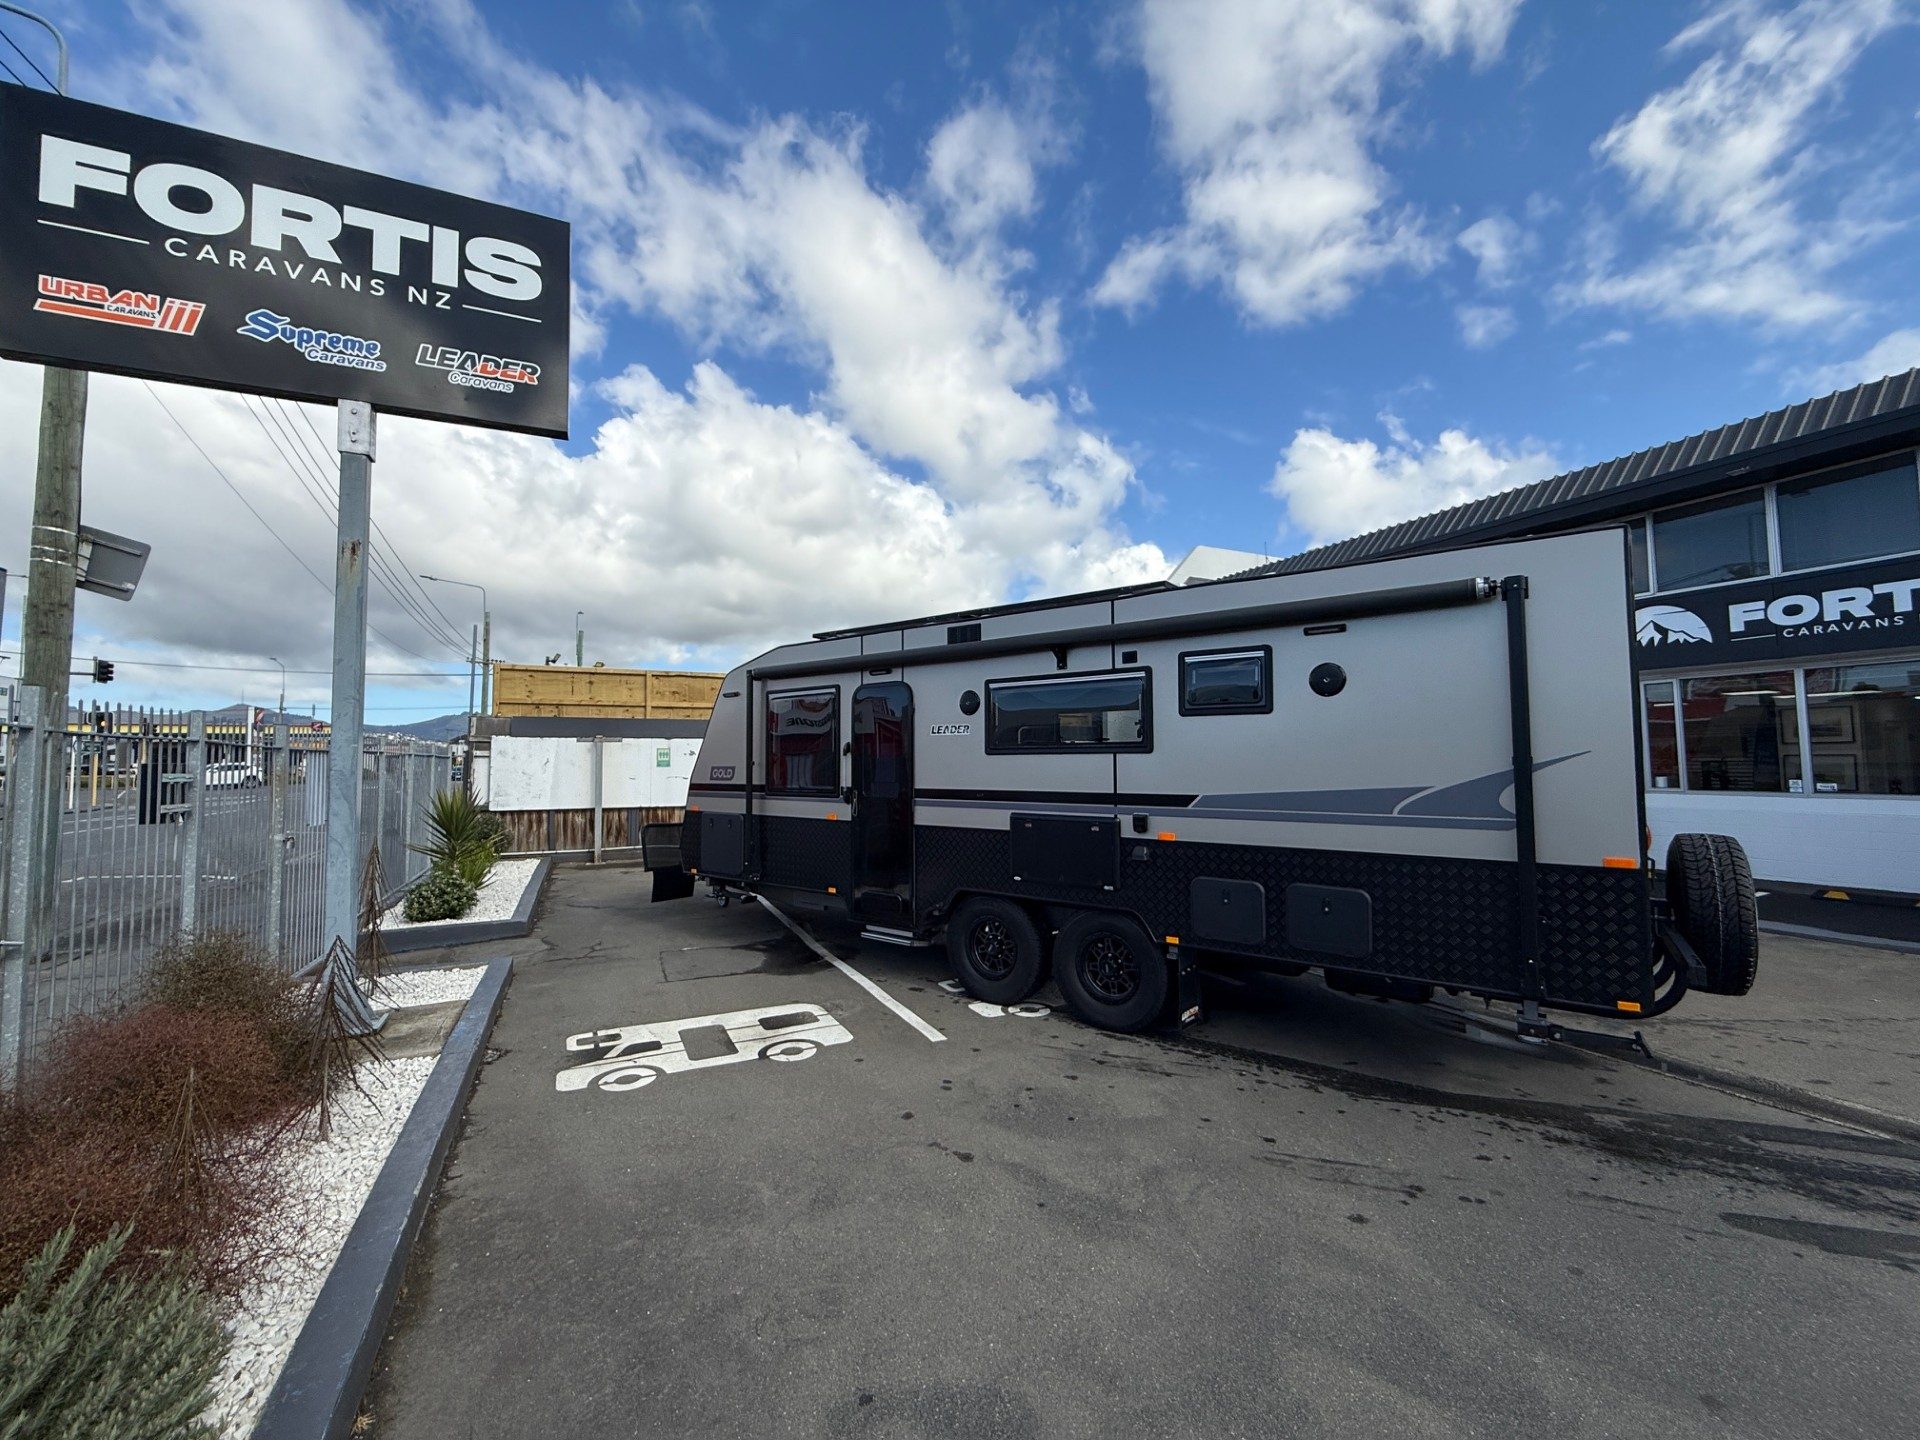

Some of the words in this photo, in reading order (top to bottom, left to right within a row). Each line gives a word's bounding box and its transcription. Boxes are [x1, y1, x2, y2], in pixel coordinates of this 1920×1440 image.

[38, 133, 543, 301] FORTIS
[164, 237, 385, 297] CARAVANS
[407, 285, 452, 310] NZ
[39, 275, 160, 312] URBAN
[106, 304, 157, 319] CARAVANS
[237, 309, 381, 358] Supreme
[306, 348, 386, 371] Caravans
[415, 343, 541, 385] LEADER
[449, 371, 514, 392] Caravans
[1782, 615, 1905, 638] CARAVANS
[930, 724, 970, 735] LEADER
[712, 768, 733, 778] GOLD
